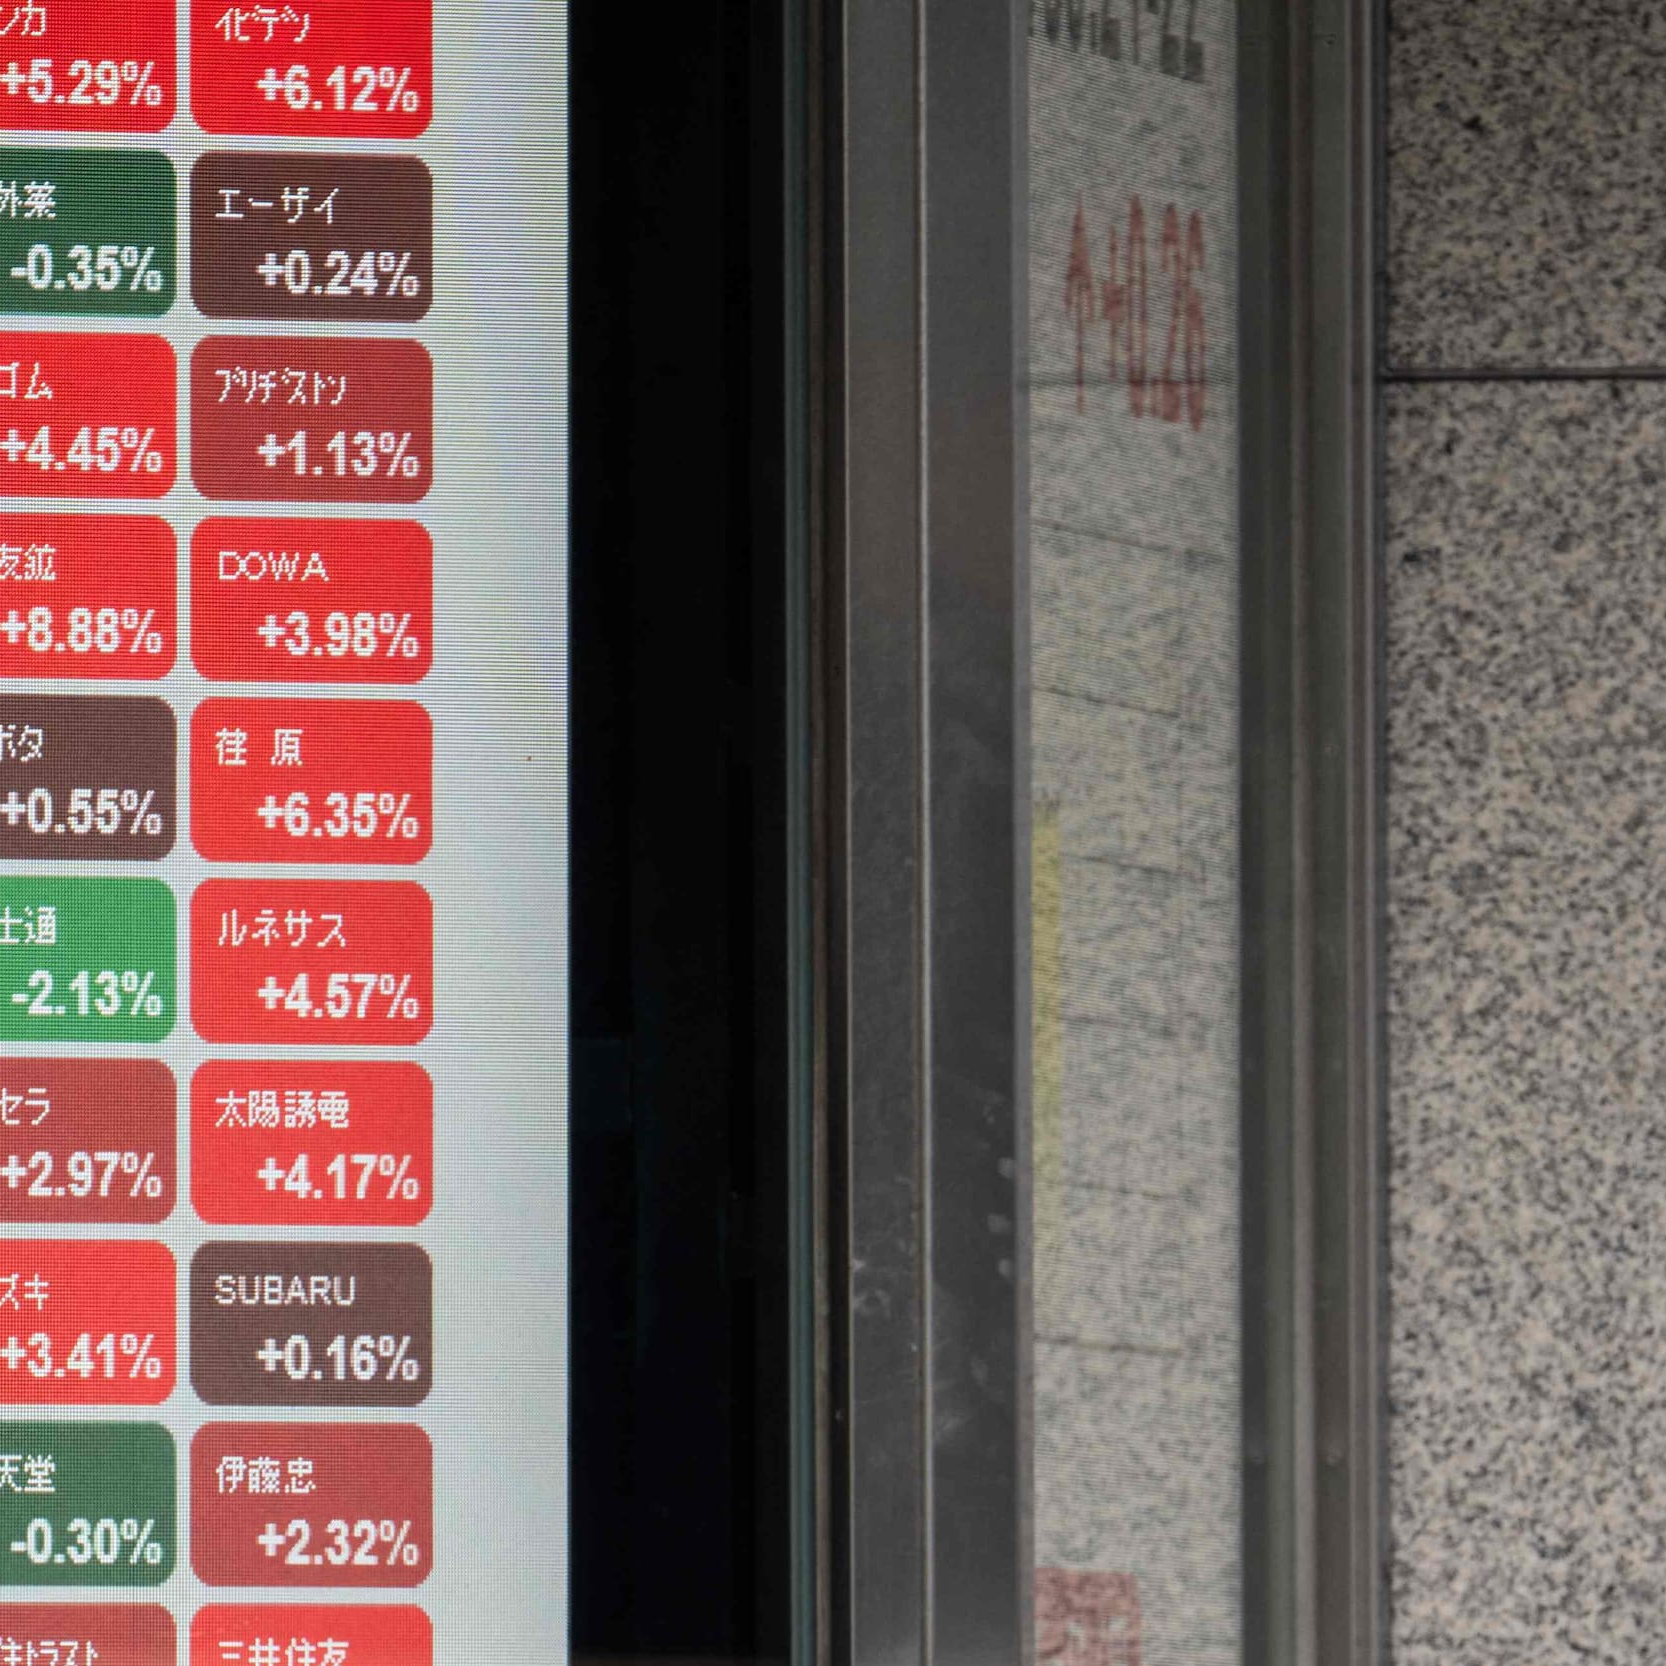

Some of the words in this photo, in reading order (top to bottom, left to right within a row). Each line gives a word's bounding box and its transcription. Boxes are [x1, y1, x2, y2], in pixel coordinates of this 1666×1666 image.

[256, 63, 420, 113] +6.12%
[215, 186, 338, 224] エーザイ
[10, 243, 163, 293] -0.35%
[256, 248, 420, 298] +0.24%
[257, 429, 420, 478] +1.13%
[216, 549, 329, 582] DOWA
[256, 609, 420, 659] +3.98%
[256, 790, 420, 839] +6.35%
[216, 908, 347, 947] ルネサス
[11, 968, 163, 1018] -2.13%
[257, 971, 420, 1020] +4.57%
[0, 1149, 164, 1199] +2.97%
[257, 1152, 420, 1200] +4.17%
[214, 1273, 357, 1307] SUBARU
[256, 1333, 420, 1382] +0.16%
[9, 1517, 163, 1566] -0.30%
[257, 1518, 420, 1567] +2.32%
